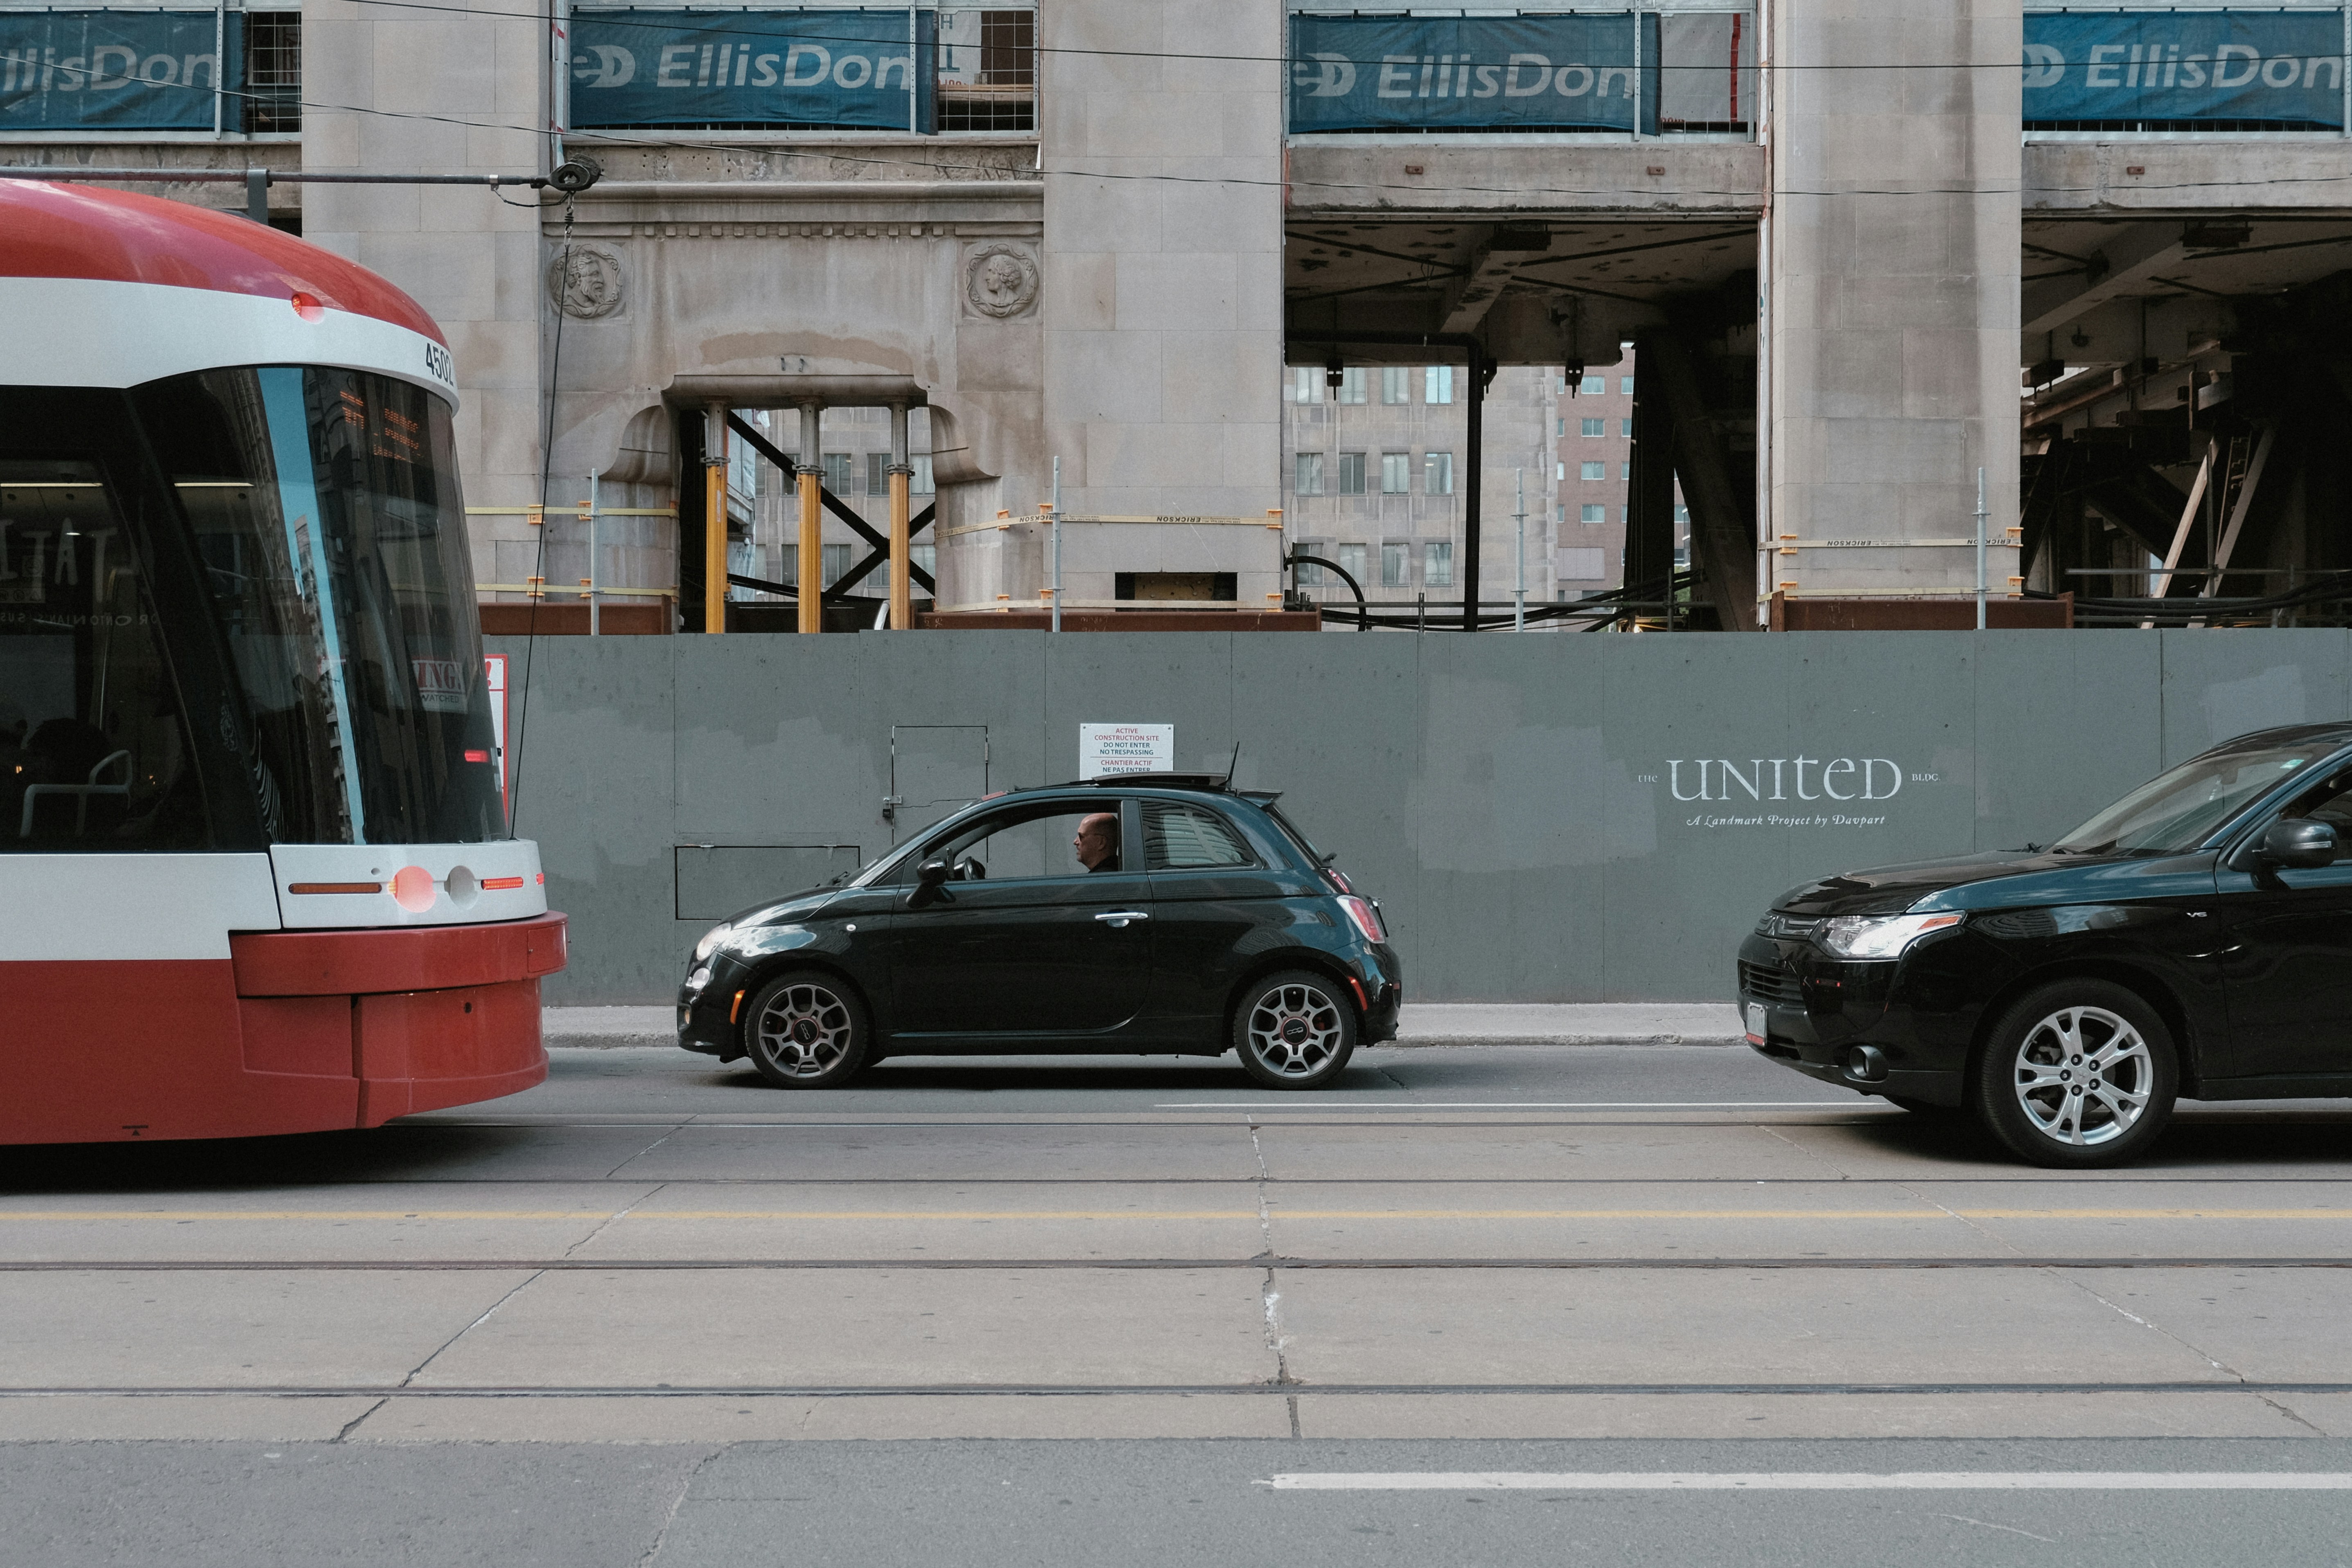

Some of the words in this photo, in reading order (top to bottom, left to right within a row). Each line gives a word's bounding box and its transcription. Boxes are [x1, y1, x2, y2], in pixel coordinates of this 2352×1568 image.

[0, 45, 217, 91] llisDon
[657, 44, 910, 90] EllisDon
[1378, 53, 1635, 100] EllisDon
[2086, 44, 2343, 89] EllisDon
[426, 343, 454, 387] 4502
[1020, 514, 1053, 523] RICKSON
[1687, 815, 1702, 826] A
[1704, 815, 1763, 827] Landmark
[1768, 814, 1810, 827] Project
[1815, 814, 1827, 827] by
[1832, 814, 1885, 827] Davpart
